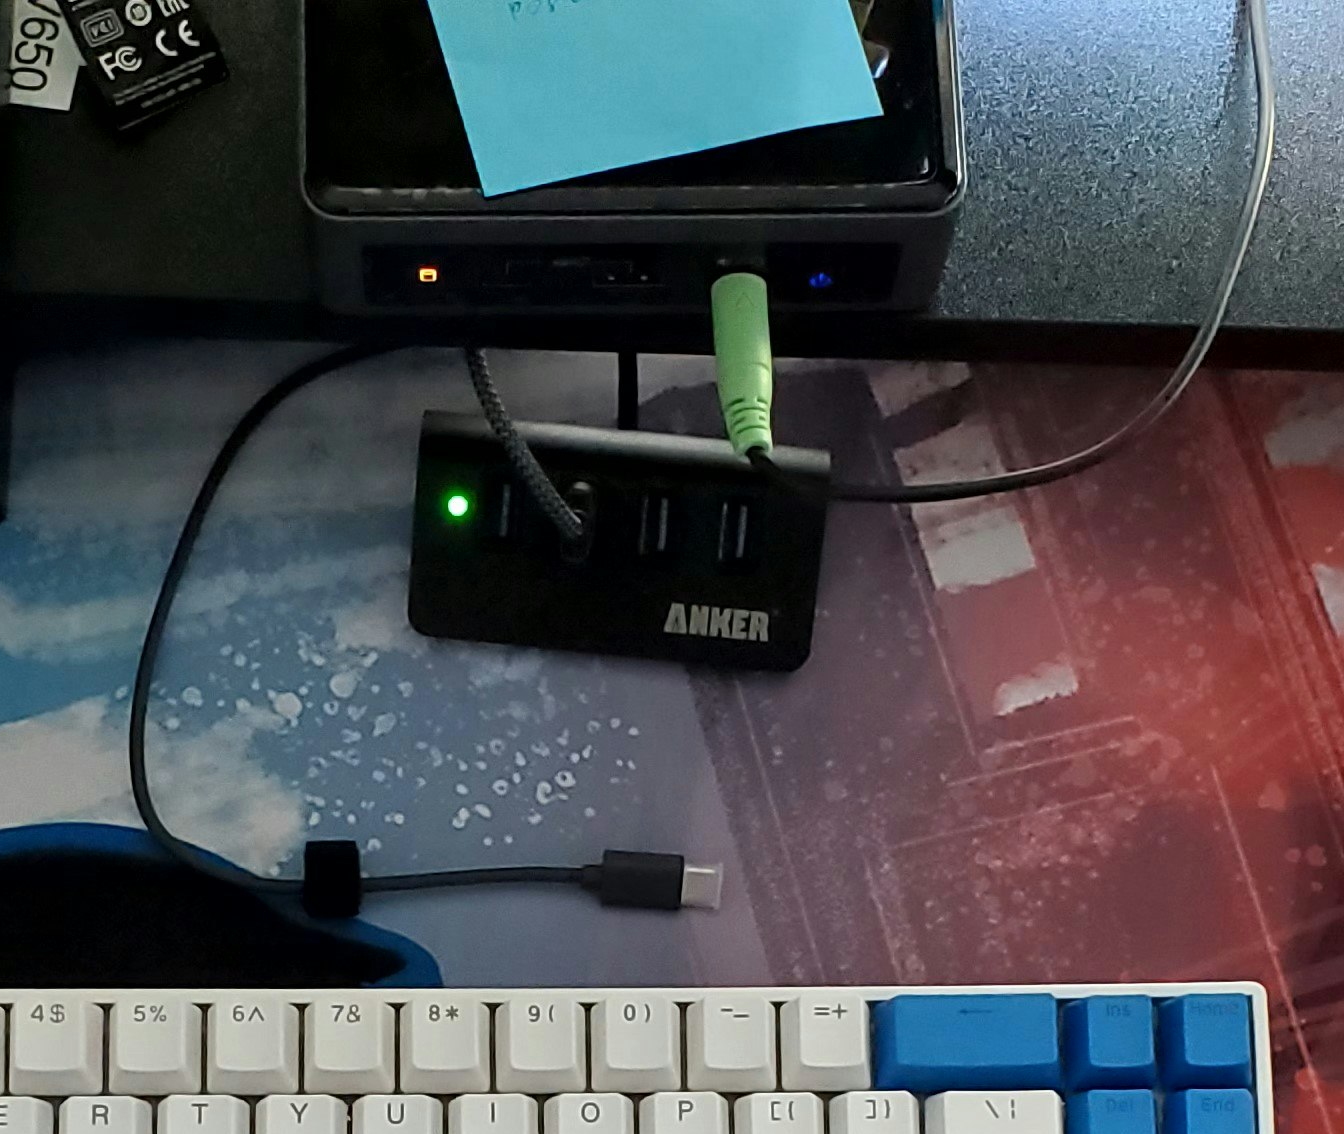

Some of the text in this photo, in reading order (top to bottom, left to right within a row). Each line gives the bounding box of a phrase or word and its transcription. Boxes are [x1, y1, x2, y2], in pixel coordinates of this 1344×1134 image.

[663, 602, 770, 643] ANKER
[91, 1104, 109, 1126] R
[191, 1103, 209, 1125] T
[289, 1102, 309, 1124] Y
[387, 1102, 405, 1125] U
[489, 1101, 497, 1123] I
[580, 1101, 601, 1124] O
[678, 1100, 694, 1122] P
